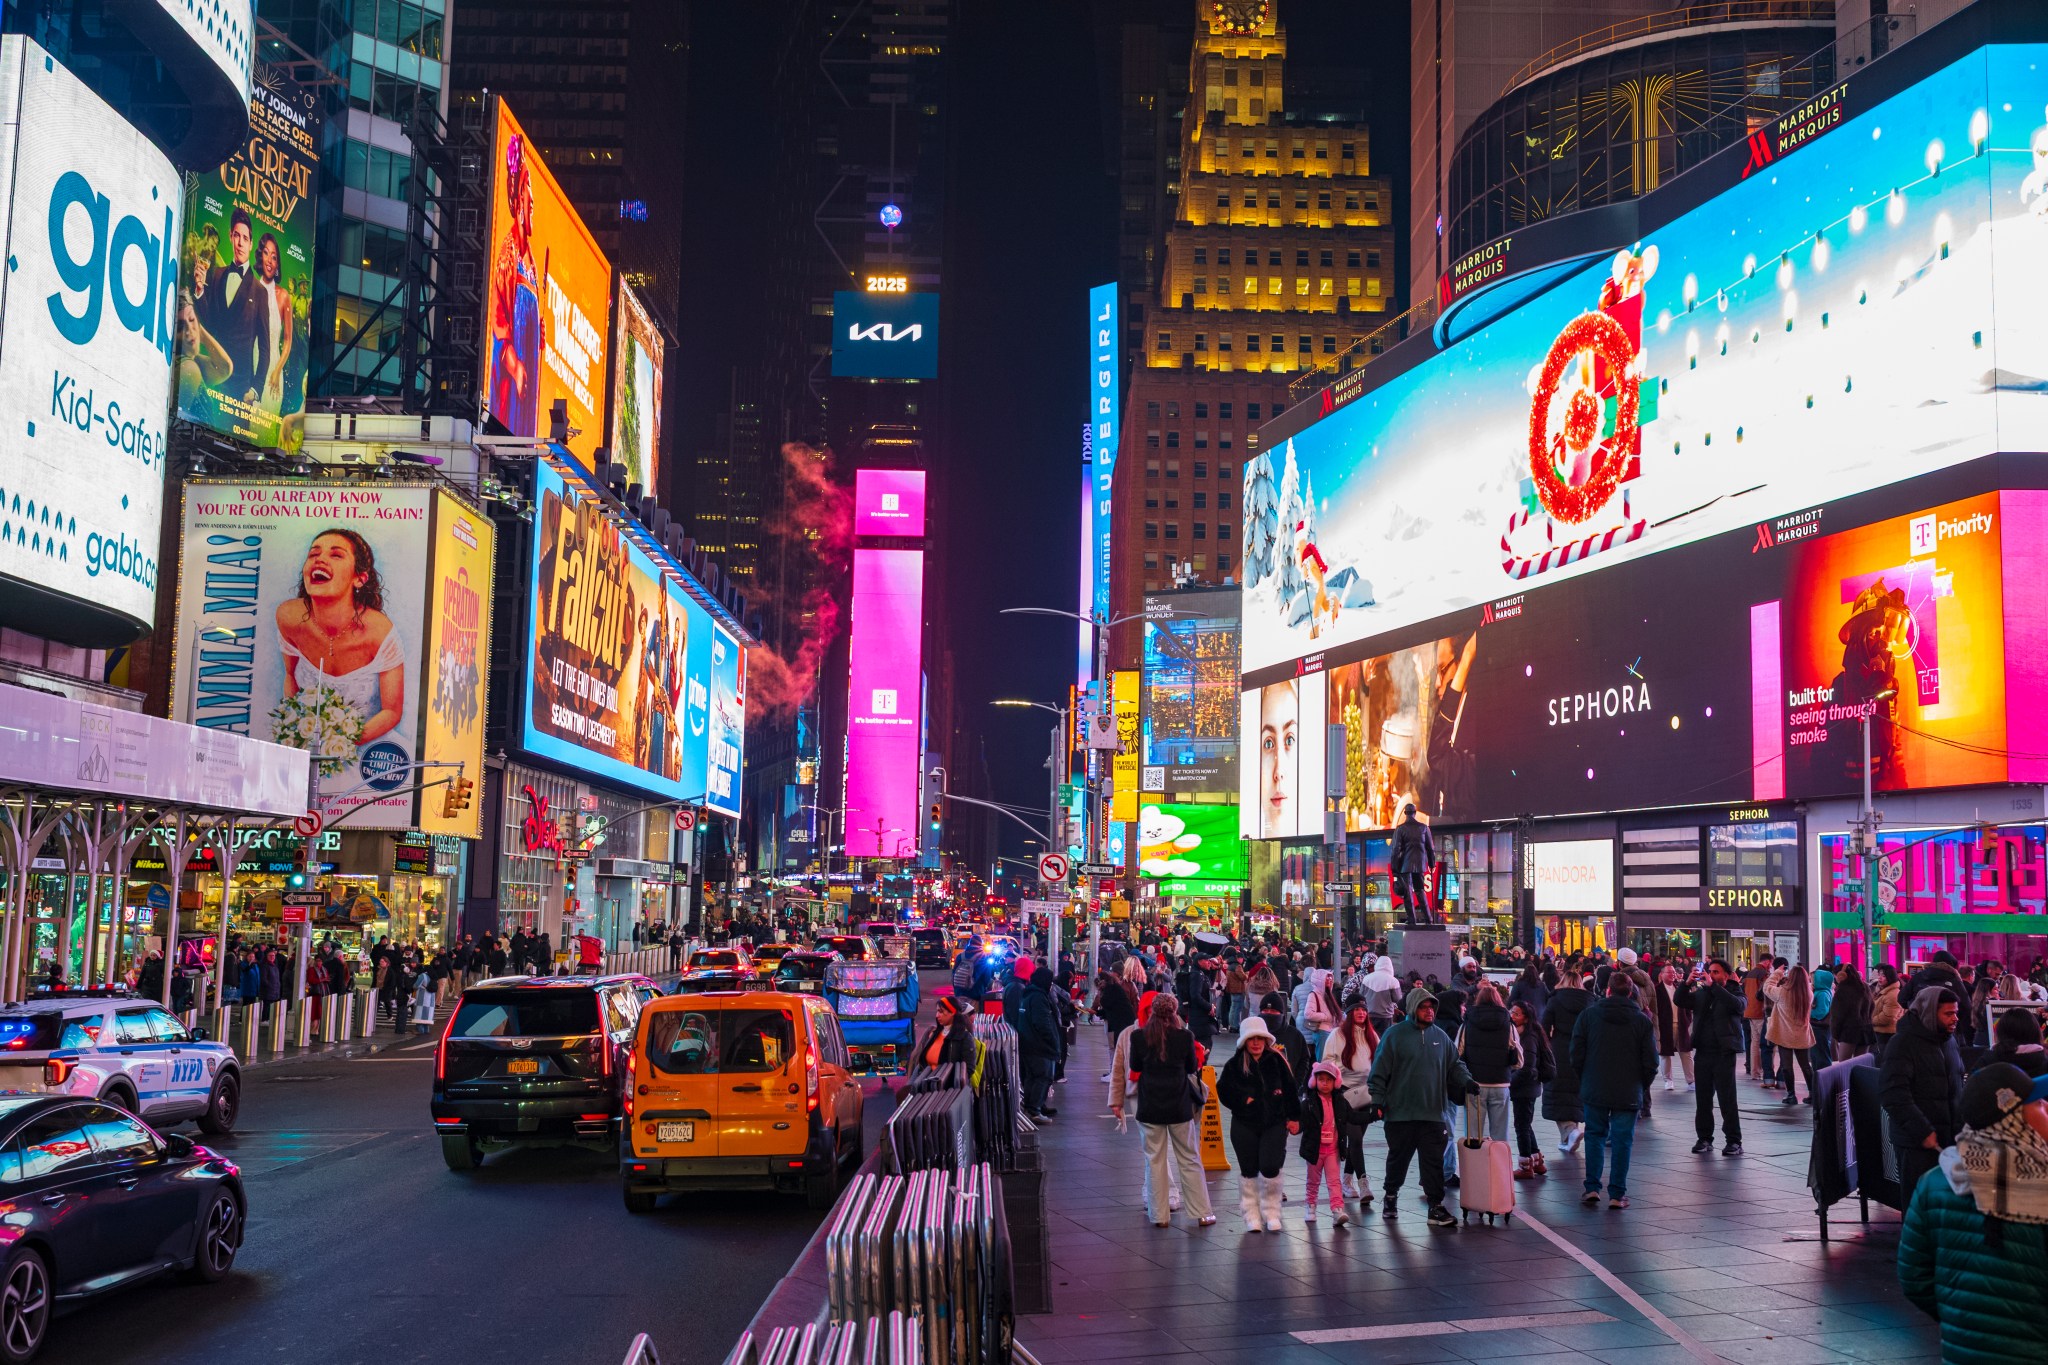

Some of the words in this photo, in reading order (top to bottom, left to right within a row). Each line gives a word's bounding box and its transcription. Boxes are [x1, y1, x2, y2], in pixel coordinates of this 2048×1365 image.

[268, 95, 306, 129] JORDAN
[1778, 83, 1848, 134] MARRIOTT
[259, 118, 268, 128] THE
[268, 122, 281, 138] BACK
[281, 132, 289, 142] OF
[289, 137, 298, 149] THE
[267, 109, 291, 135] FACE
[292, 127, 314, 149] OFF!
[1779, 108, 1842, 153] MARQUIS
[249, 137, 311, 199] GREAT
[220, 157, 298, 222] GATSBY
[204, 203, 223, 218] JORDAN
[205, 195, 223, 210] JEREMY
[232, 198, 239, 208] A
[239, 200, 256, 216] NEW
[256, 213, 285, 234] MUSICAL
[1455, 237, 1513, 277] MARRIOTT
[866, 277, 908, 292] 2025
[1455, 256, 1505, 294] MARQUIS
[546, 272, 572, 329] TONY
[849, 322, 922, 342] KIA
[554, 313, 590, 387] WINNING
[544, 342, 576, 392] BROADWAY
[573, 377, 595, 416] MUSICAL
[1335, 368, 1366, 395] MARRIOTT
[1335, 383, 1363, 407] MARQUIS
[51, 369, 152, 465] Kid-Safe
[225, 395, 258, 414] BROADWAY
[258, 408, 283, 426] THEATRE
[234, 409, 240, 417] &
[240, 411, 273, 430] BROADWAY
[1098, 301, 1113, 517] SUPERGIRL
[239, 489, 268, 502] YOU
[271, 490, 337, 504] ALREADY
[339, 491, 384, 505] KNOW
[197, 503, 248, 518] YOU'RE
[250, 504, 301, 518] GONNA
[305, 504, 342, 519] LOVE
[345, 506, 370, 520] IT...
[373, 507, 424, 521] AGAIN!
[1777, 508, 1824, 530] MARRIOTT
[1777, 524, 1819, 543] MARQUIS
[1916, 521, 1931, 548] T
[1938, 511, 1994, 541] Priority
[85, 532, 158, 593] gabb.co
[655, 507, 748, 625] BROADWAY
[1103, 532, 1112, 584] STUDIOS
[203, 534, 262, 616] MIA!
[548, 503, 631, 672] Fallout
[443, 575, 480, 630] OPERATION
[1146, 597, 1159, 605] RE-
[1146, 604, 1173, 612] IMAGINE
[1495, 595, 1525, 610] MARRIOTT
[1495, 606, 1522, 620] MARQUIS
[195, 625, 257, 737] AMMA
[552, 656, 565, 687] LET
[565, 662, 577, 694] THE
[576, 669, 590, 699] END
[589, 676, 607, 708] TIMES
[605, 685, 619, 714] ROLL
[688, 672, 707, 712] prime
[1548, 682, 1652, 726] SEPHORA
[1789, 688, 1816, 708] built
[1817, 686, 1835, 703] for
[81, 716, 110, 733] ROCK
[551, 702, 574, 732] SEASON
[573, 711, 586, 736] TWO
[587, 718, 612, 747] DECEMBER
[1789, 706, 1827, 729] seeing
[1829, 699, 1878, 721] through
[1789, 728, 1828, 746] smoke
[369, 750, 405, 764] STRICTLY
[362, 766, 405, 781] ENGAEMENT
[370, 797, 409, 808] Theatre
[1729, 808, 1770, 821] SEPHORA
[2011, 799, 2033, 811] 1535
[205, 828, 342, 851] LUGGE
[278, 839, 284, 849] W
[285, 839, 294, 849] 46
[430, 833, 460, 854] LUGGAGE
[790, 829, 808, 838] CALL
[135, 859, 165, 870] Nikon
[1537, 865, 1598, 884] PANDORA
[1204, 884, 1229, 892] KPOP
[1423, 874, 1433, 893] S
[1708, 889, 1784, 908] SEPHORA
[745, 983, 767, 992] 6G98
[171, 1058, 204, 1083] NYPD
